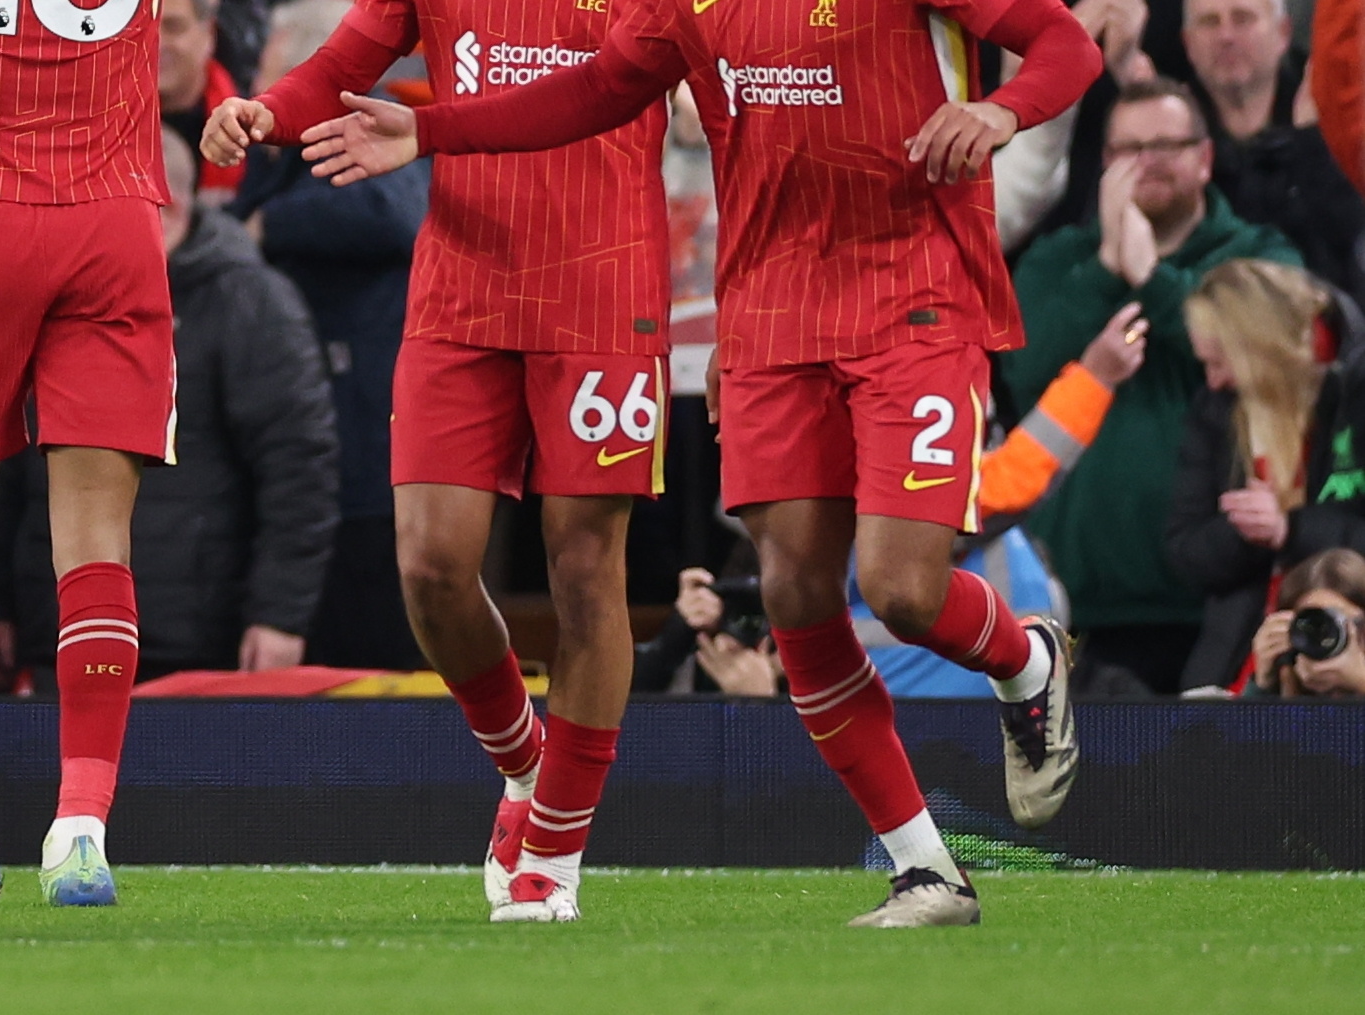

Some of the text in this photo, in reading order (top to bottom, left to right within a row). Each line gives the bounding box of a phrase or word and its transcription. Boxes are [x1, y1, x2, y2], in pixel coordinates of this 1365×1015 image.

[735, 64, 833, 85] standard
[741, 83, 843, 106] chartered
[569, 370, 658, 443] 66
[911, 394, 955, 466] 2
[84, 663, 123, 676] LFC
